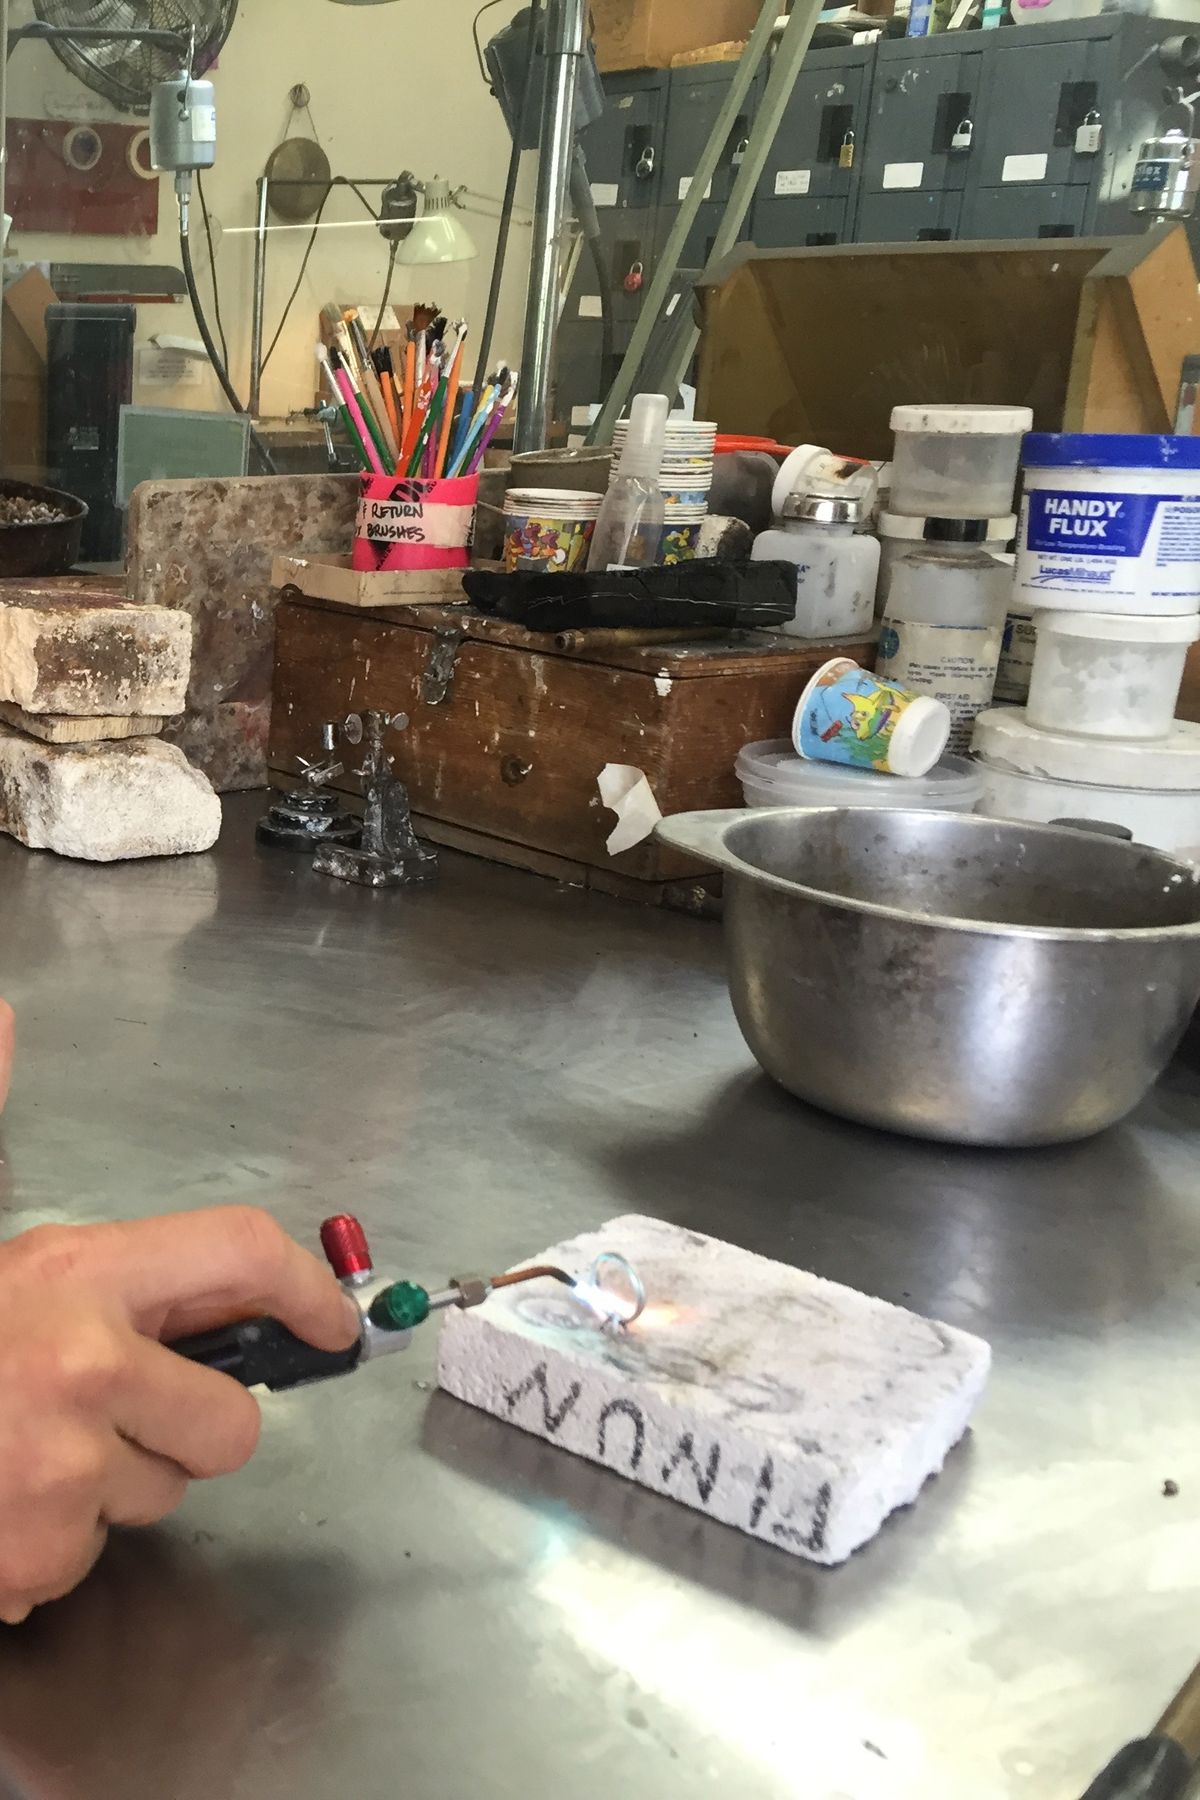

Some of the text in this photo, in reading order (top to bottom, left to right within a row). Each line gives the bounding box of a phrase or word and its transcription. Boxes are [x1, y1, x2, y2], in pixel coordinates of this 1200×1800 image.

[371, 502, 423, 519] RETURN
[1044, 498, 1123, 518] HANDY
[366, 523, 426, 542] BRUSHES
[1049, 518, 1109, 537] FLUX
